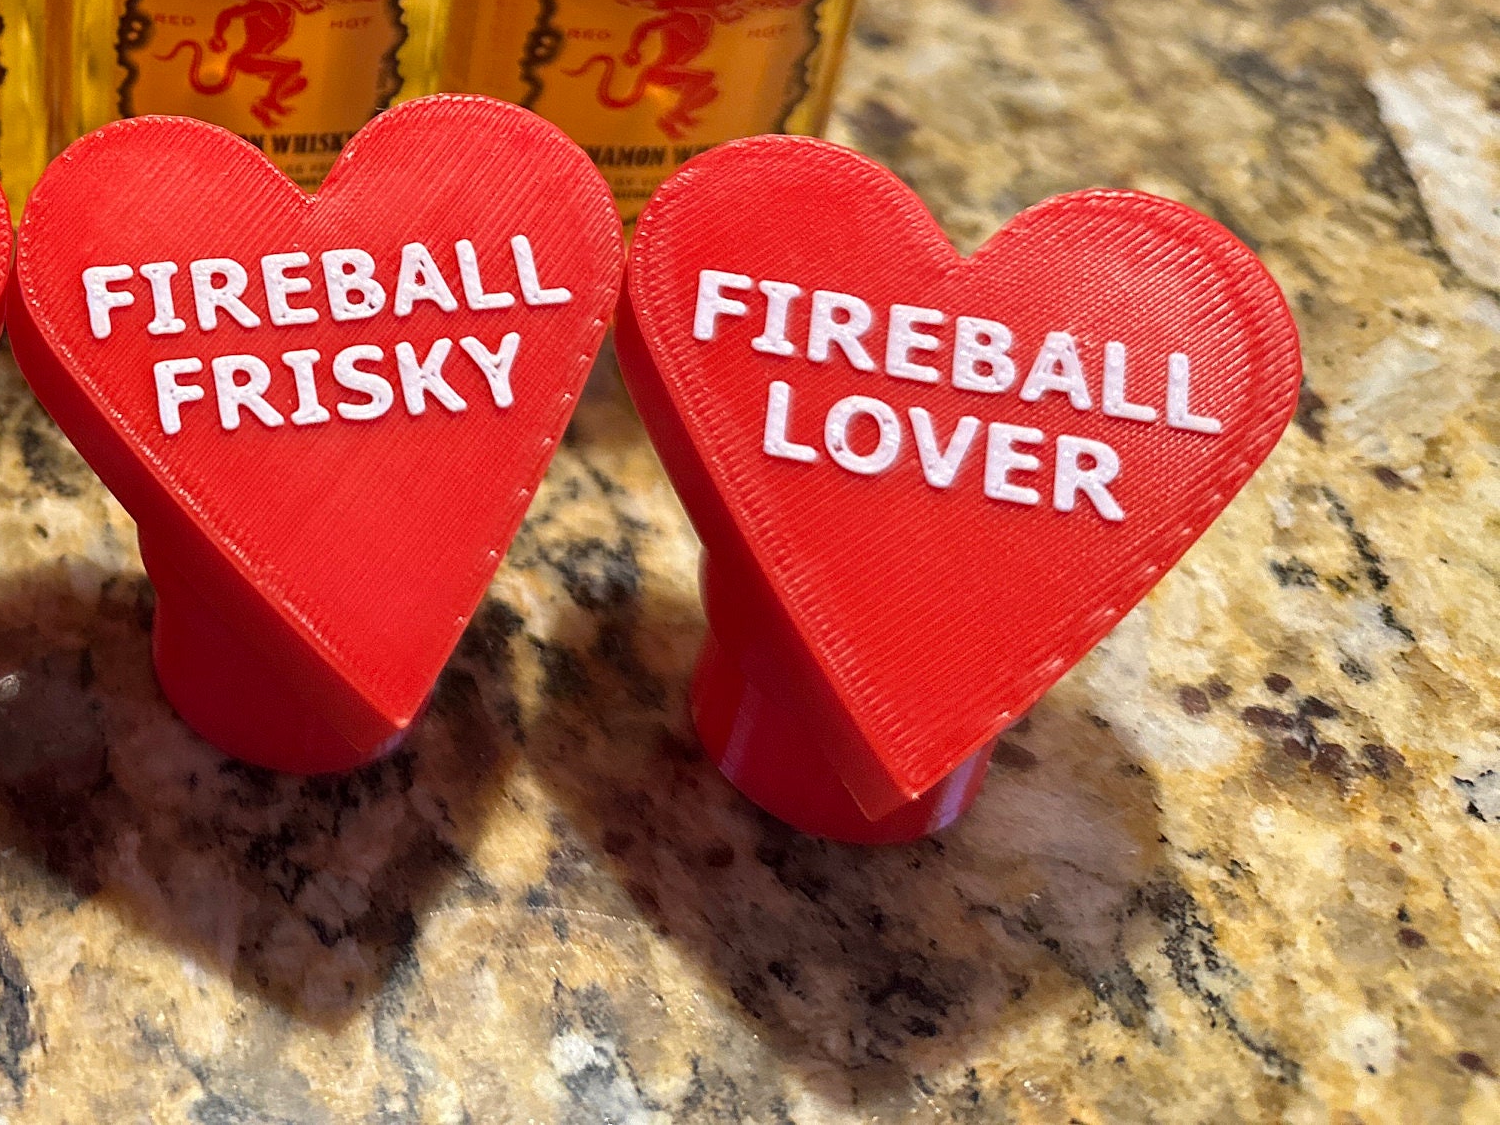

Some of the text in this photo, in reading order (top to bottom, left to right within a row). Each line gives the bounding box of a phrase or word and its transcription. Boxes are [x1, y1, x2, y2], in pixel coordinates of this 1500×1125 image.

[154, 13, 374, 30] RED HOT
[584, 144, 666, 167] NAMON
[81, 234, 574, 340] FIREBALL
[152, 331, 522, 435] FRISKY
[692, 269, 1223, 435] FIREBALL
[762, 380, 1126, 522] LOVER
